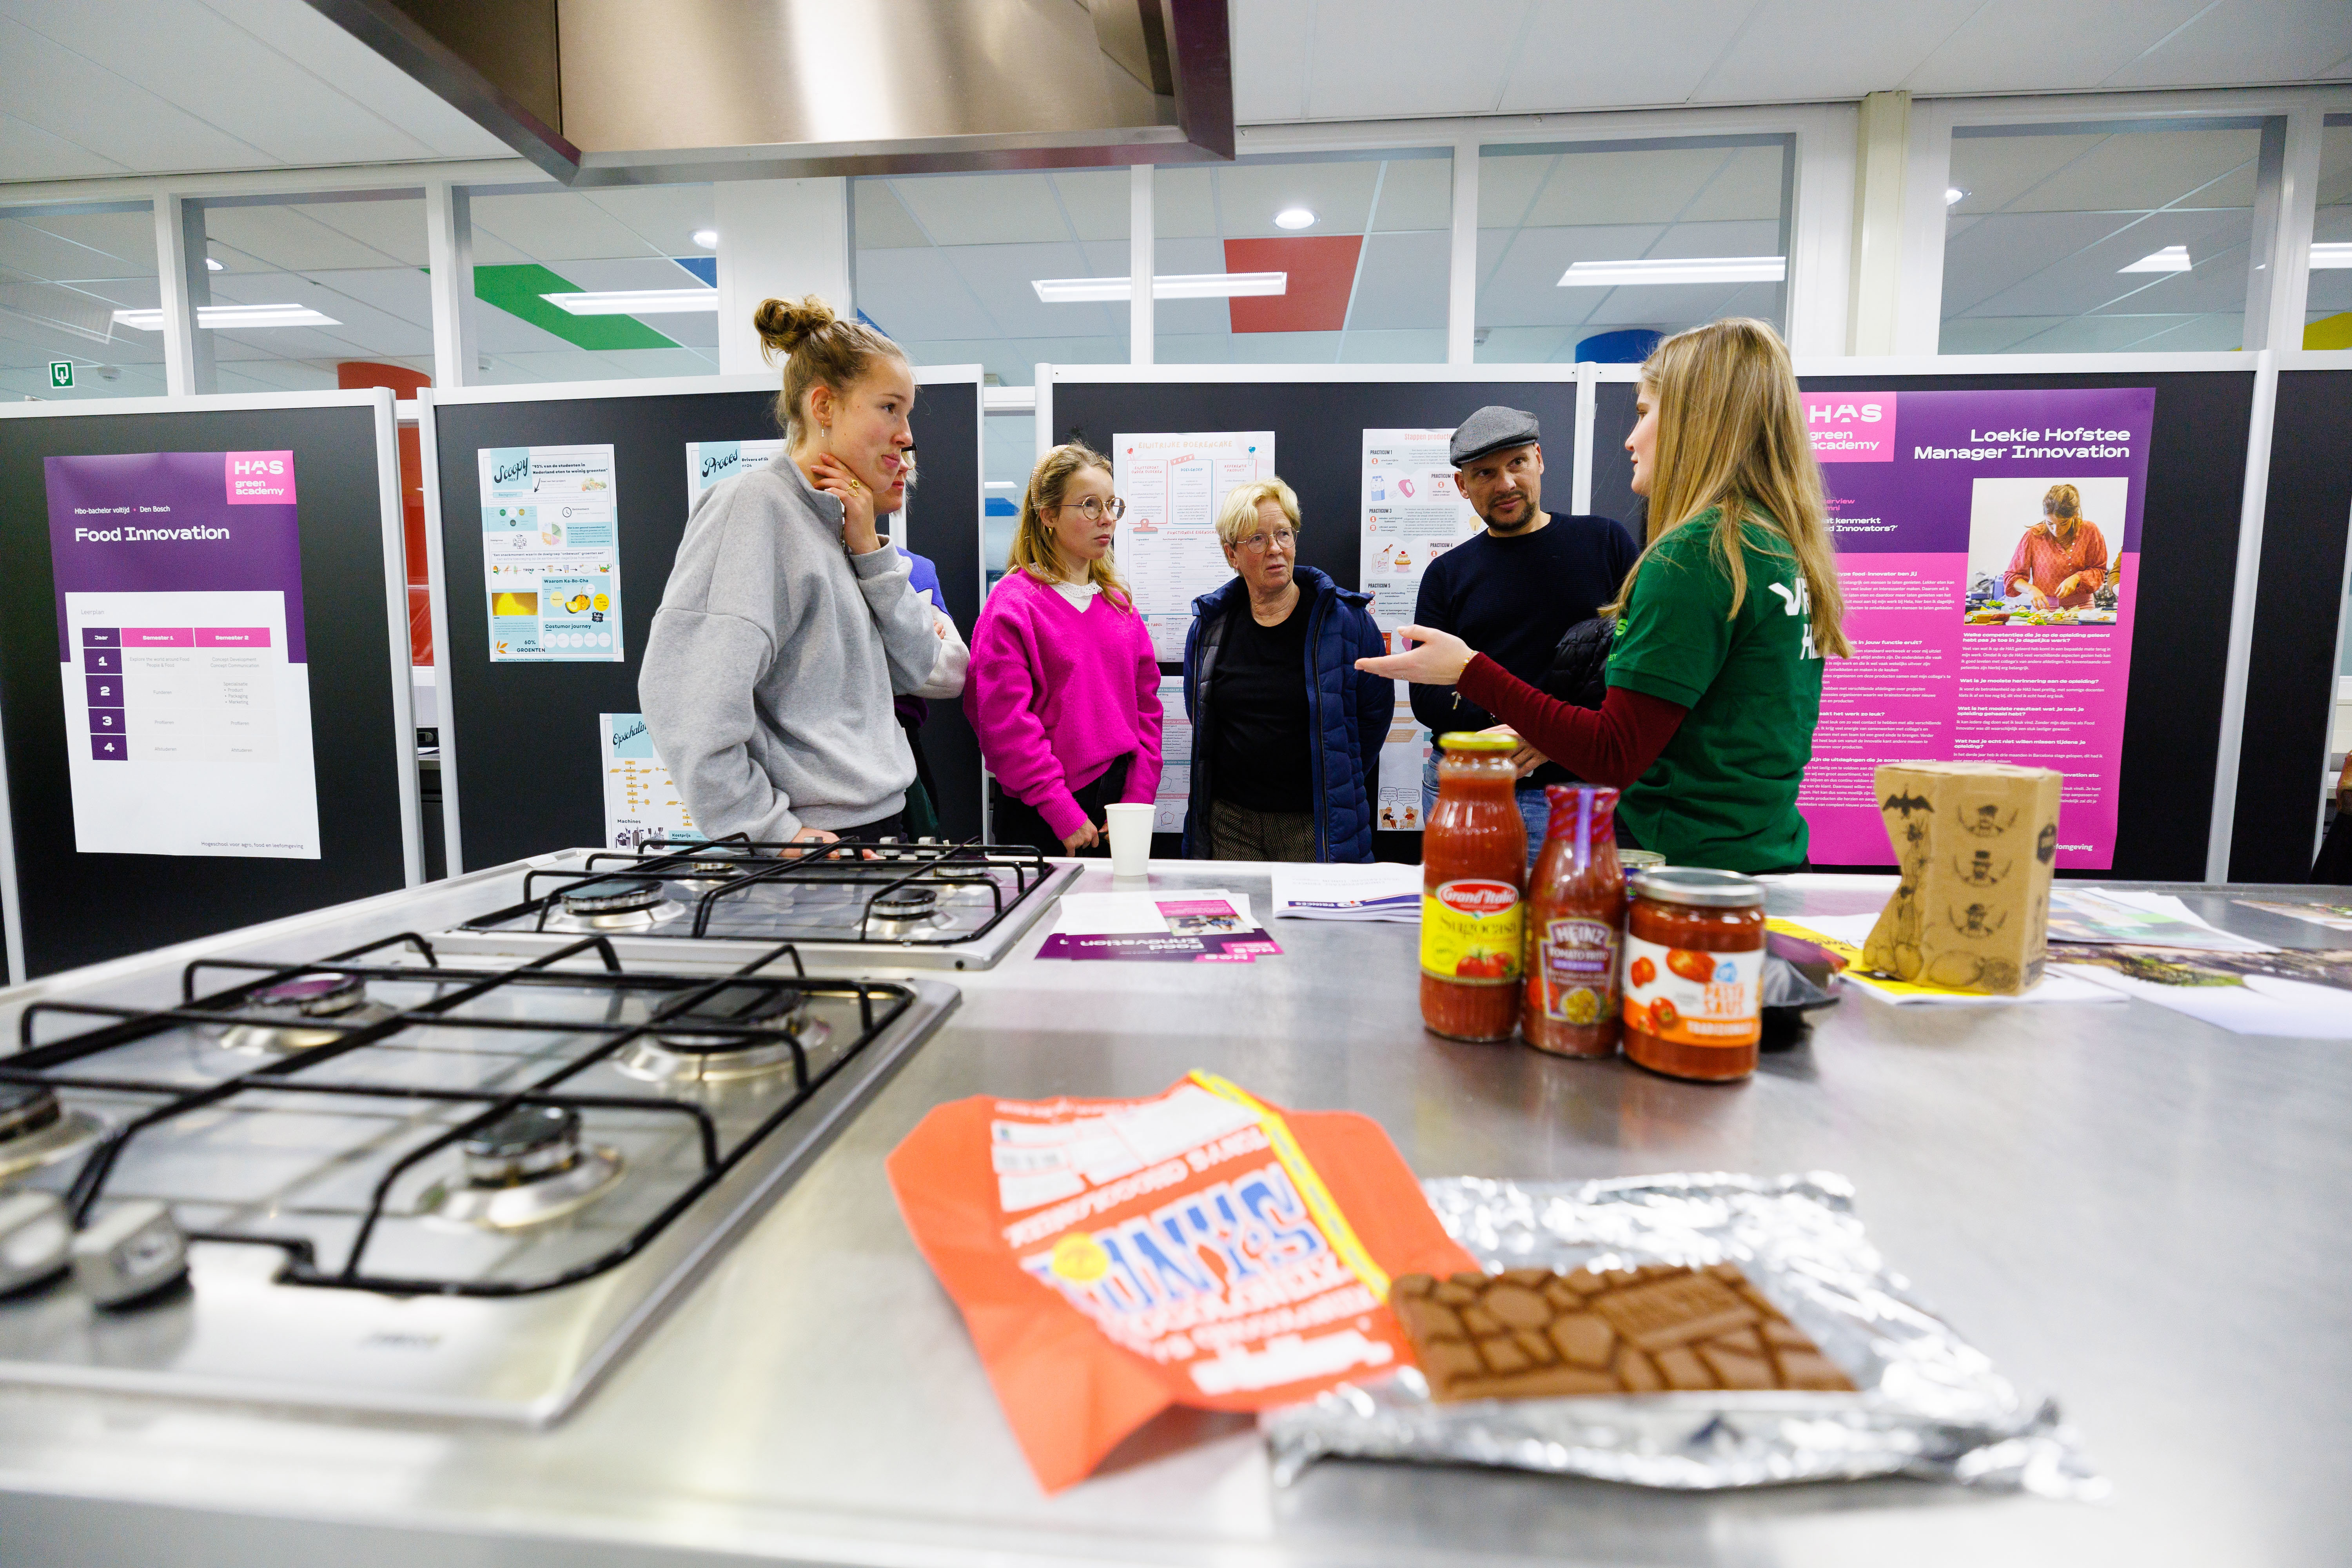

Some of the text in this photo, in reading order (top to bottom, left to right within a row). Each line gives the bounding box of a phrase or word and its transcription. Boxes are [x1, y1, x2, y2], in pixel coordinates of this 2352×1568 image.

[1809, 404, 1882, 423] HAS
[1810, 430, 1853, 441] green
[1971, 428, 2130, 442] Loekie Hofstee
[1811, 440, 1880, 452] academy
[1914, 445, 2130, 462] Manager Innovation
[235, 460, 283, 475] HAS
[702, 449, 738, 477] Proces
[494, 457, 528, 483] Scoopy
[235, 480, 265, 488] green
[236, 487, 284, 496] academy
[75, 525, 230, 543] Food Innovation
[99, 657, 107, 666] 1
[100, 686, 110, 696] 2
[103, 716, 112, 726] 3
[613, 721, 648, 748] Opschalin
[104, 742, 115, 752] 4
[1555, 925, 1605, 945] HEINZ
[1080, 938, 1200, 946] Innovation
